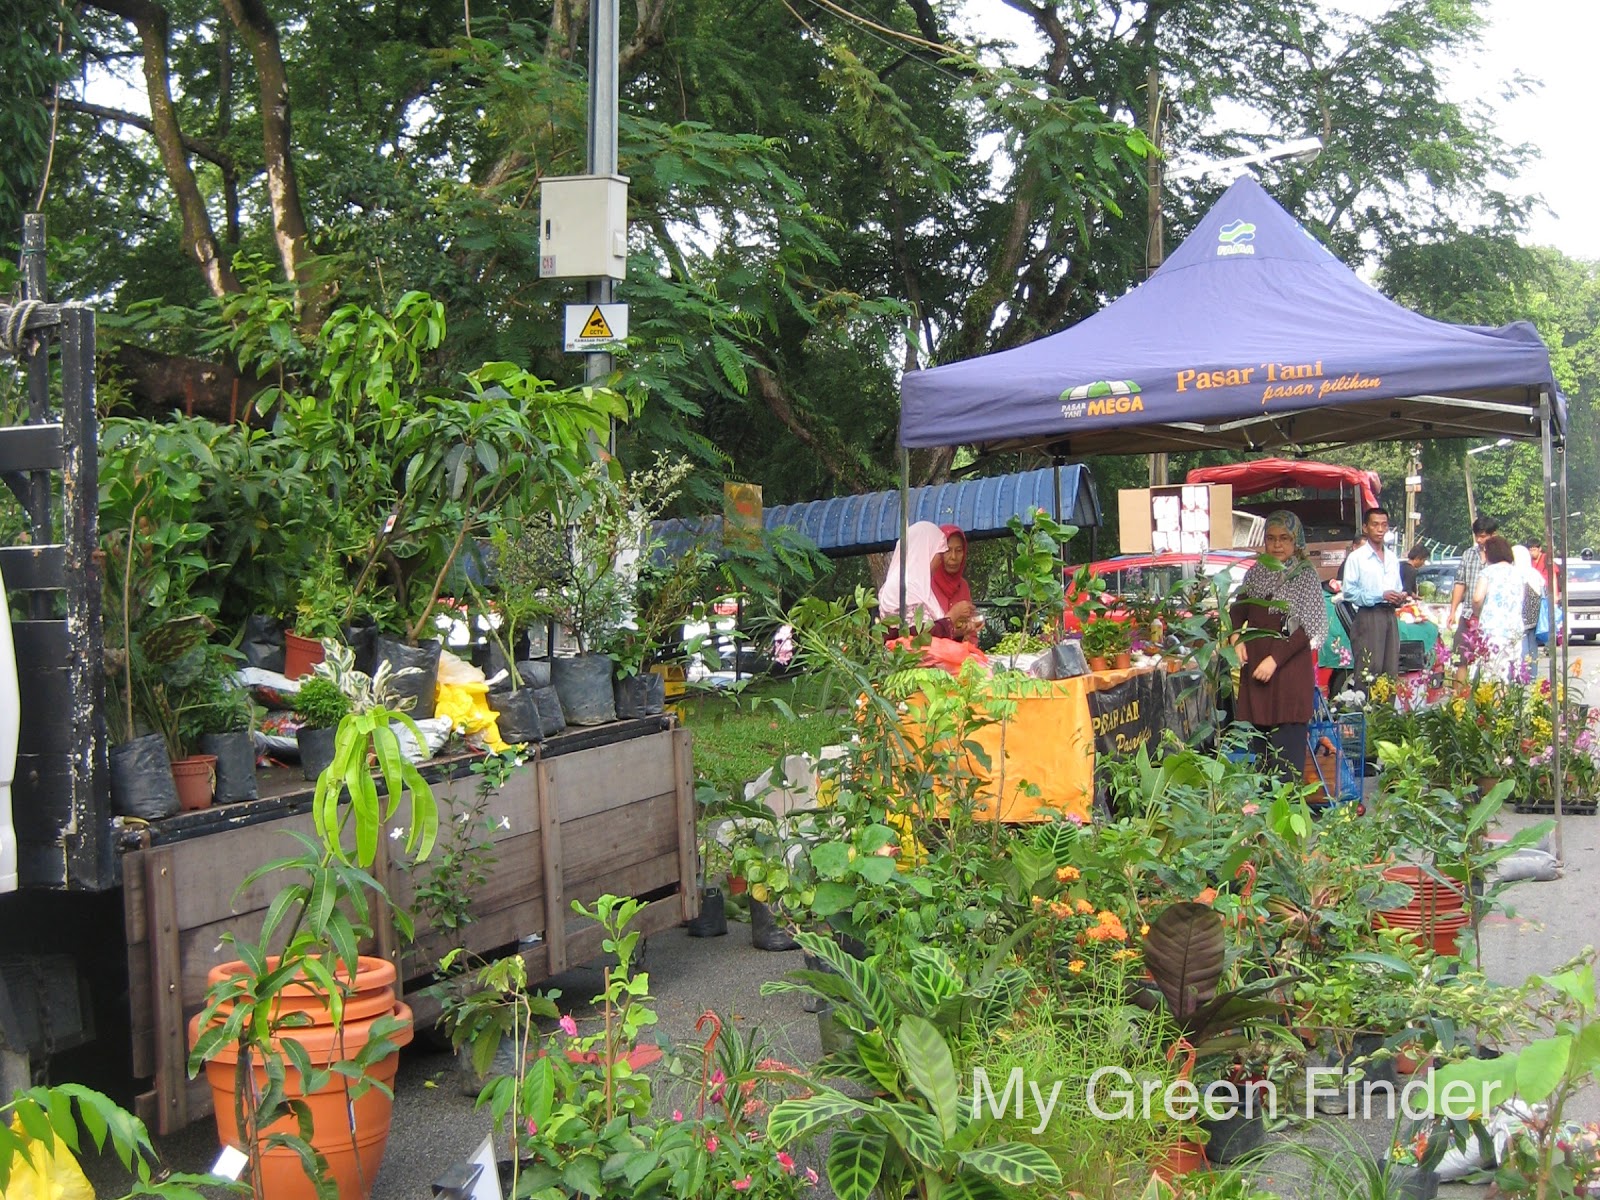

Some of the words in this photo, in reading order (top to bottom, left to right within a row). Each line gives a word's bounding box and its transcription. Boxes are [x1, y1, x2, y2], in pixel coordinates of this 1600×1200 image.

[1175, 367, 1254, 392] Pasar
[1260, 360, 1322, 383] Tani
[1261, 383, 1314, 405] pasar
[1318, 372, 1381, 399] pilihan
[1061, 402, 1087, 412] PASAR
[1063, 410, 1083, 418] TANI
[1087, 395, 1144, 417] MEGA
